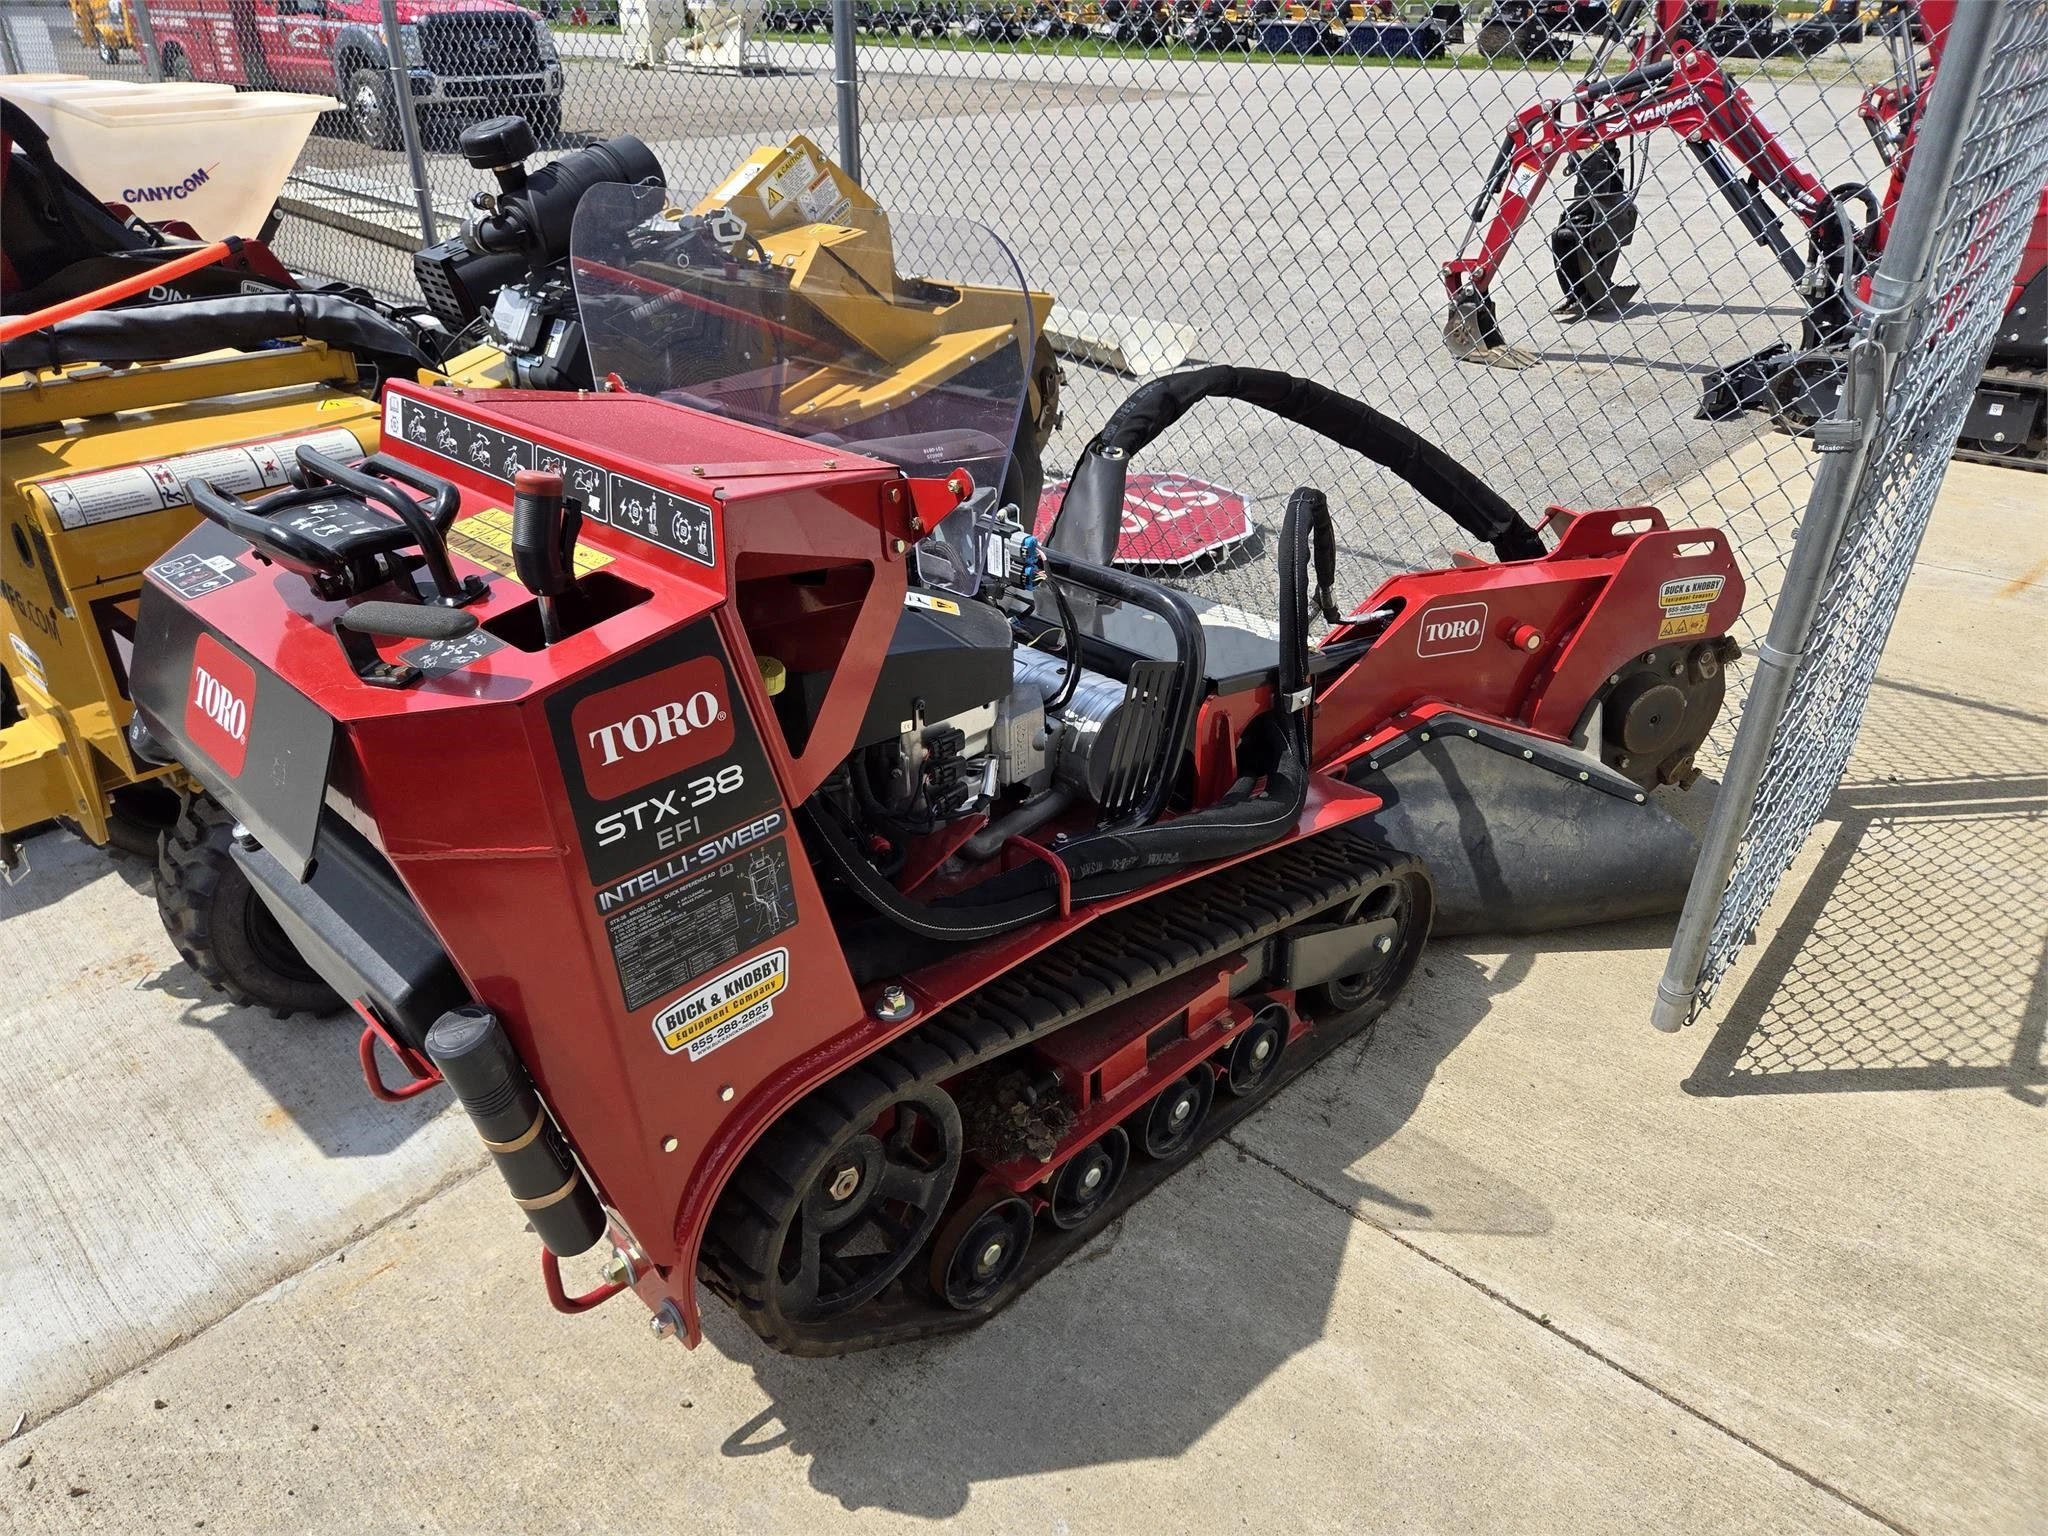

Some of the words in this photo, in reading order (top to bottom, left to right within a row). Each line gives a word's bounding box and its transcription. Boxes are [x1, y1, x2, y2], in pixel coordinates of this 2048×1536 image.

[122, 167, 210, 203] CANYCOM
[1664, 584, 1684, 595] BUCK
[1685, 585, 1691, 593] &
[1692, 580, 1721, 591] KNOBBY
[1425, 618, 1480, 642] TORO
[194, 665, 247, 740] TORO
[588, 690, 720, 766] TORO
[656, 815, 701, 850] EFI
[598, 813, 782, 911] INTELLI-SWEEP
[664, 889, 680, 900] QUICK
[665, 997, 708, 1031] BUCK
[710, 993, 722, 1007] &
[723, 956, 779, 1000] KNOBBY
[676, 1006, 730, 1041] Equipment
[732, 979, 776, 1009] Company
[691, 1002, 769, 1053] 855-288-2825
